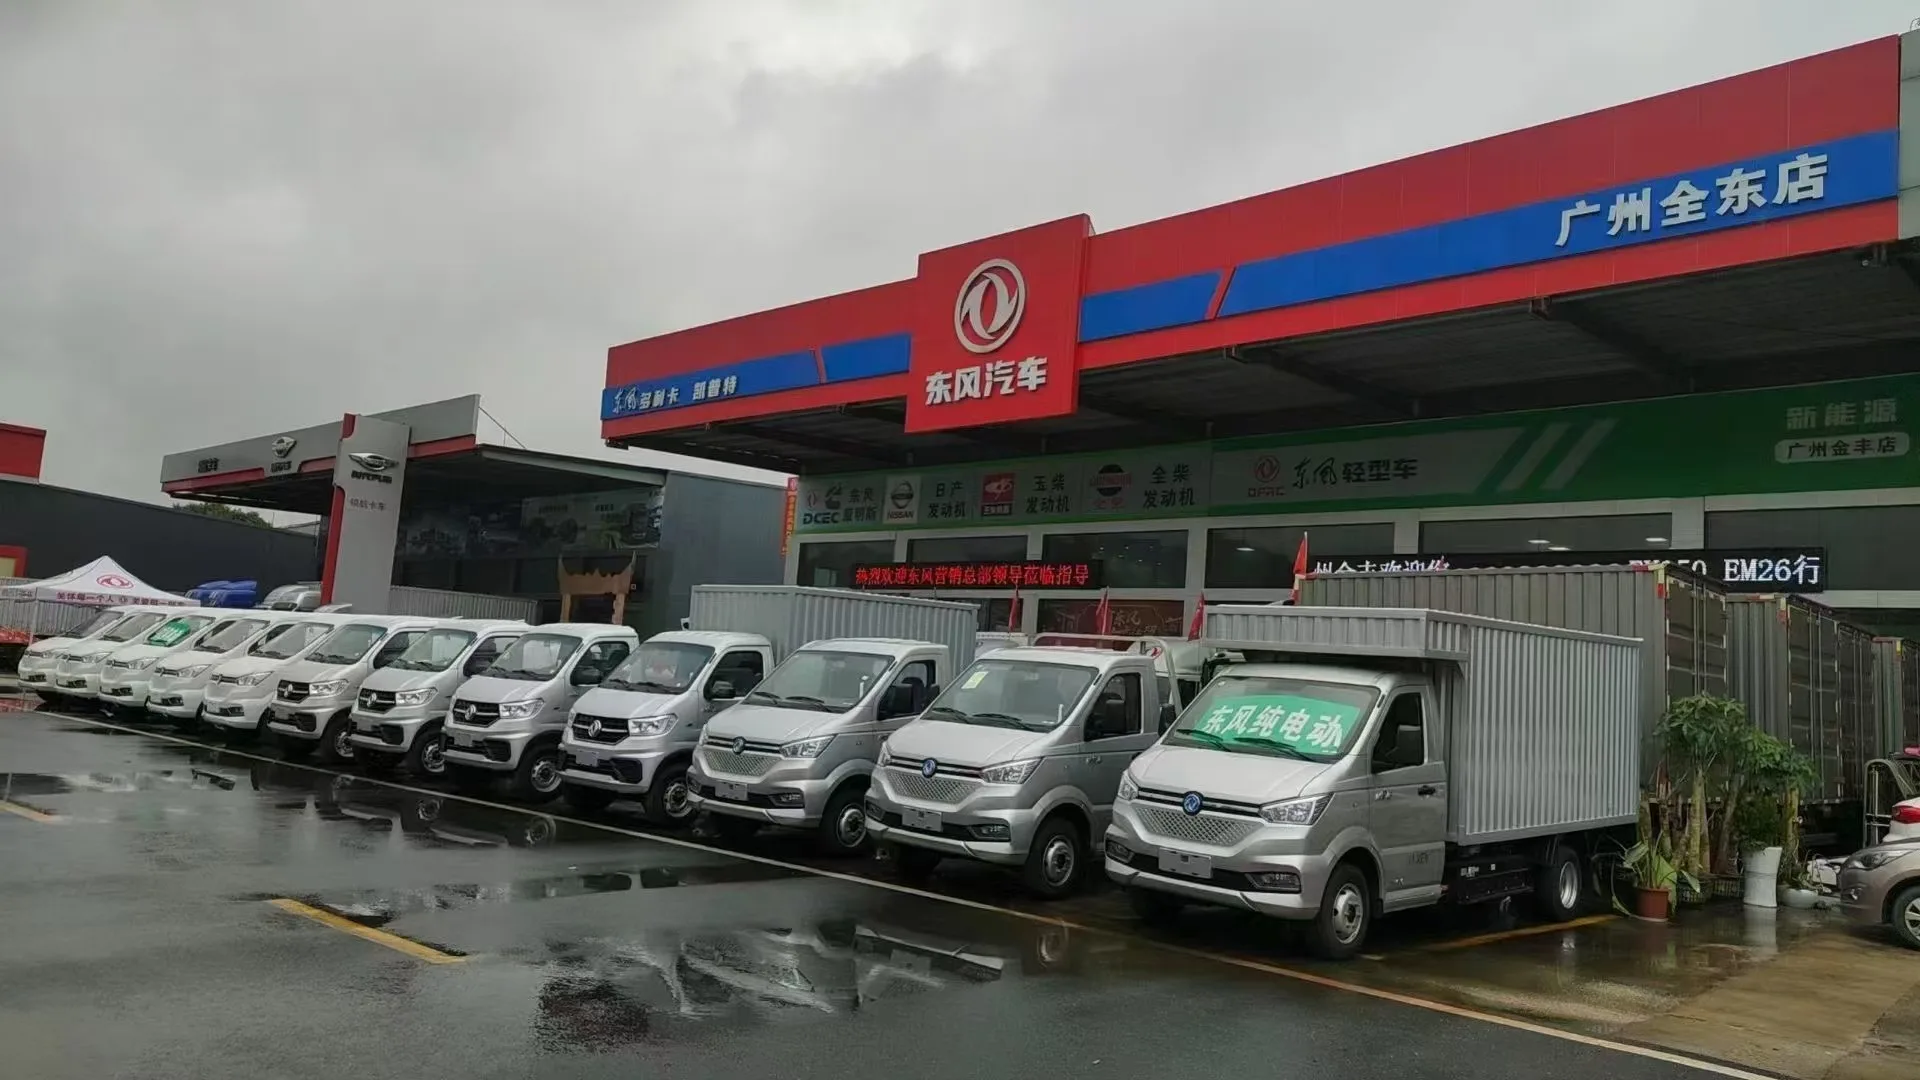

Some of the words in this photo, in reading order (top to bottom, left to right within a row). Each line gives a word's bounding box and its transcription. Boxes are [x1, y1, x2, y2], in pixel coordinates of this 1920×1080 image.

[1555, 153, 1828, 246] 广州全东店
[692, 375, 737, 400] 凯普特
[925, 356, 1048, 405] 东风汽车
[1786, 398, 1897, 429] 新能源
[1787, 436, 1897, 459] 广州金丰店
[1033, 472, 1065, 492] 玉柴
[1150, 463, 1190, 484] 全柴
[935, 481, 964, 498] 日产
[1143, 487, 1195, 509] 发动机
[928, 502, 966, 519] 发动机
[1025, 495, 1070, 514] 发动机
[803, 512, 840, 524] DCEC
[887, 511, 914, 520] NISSAN
[856, 564, 1089, 585] 热烈欢迎东风营销总部领导莅临指导
[1203, 705, 1343, 748] 东风纯电动
